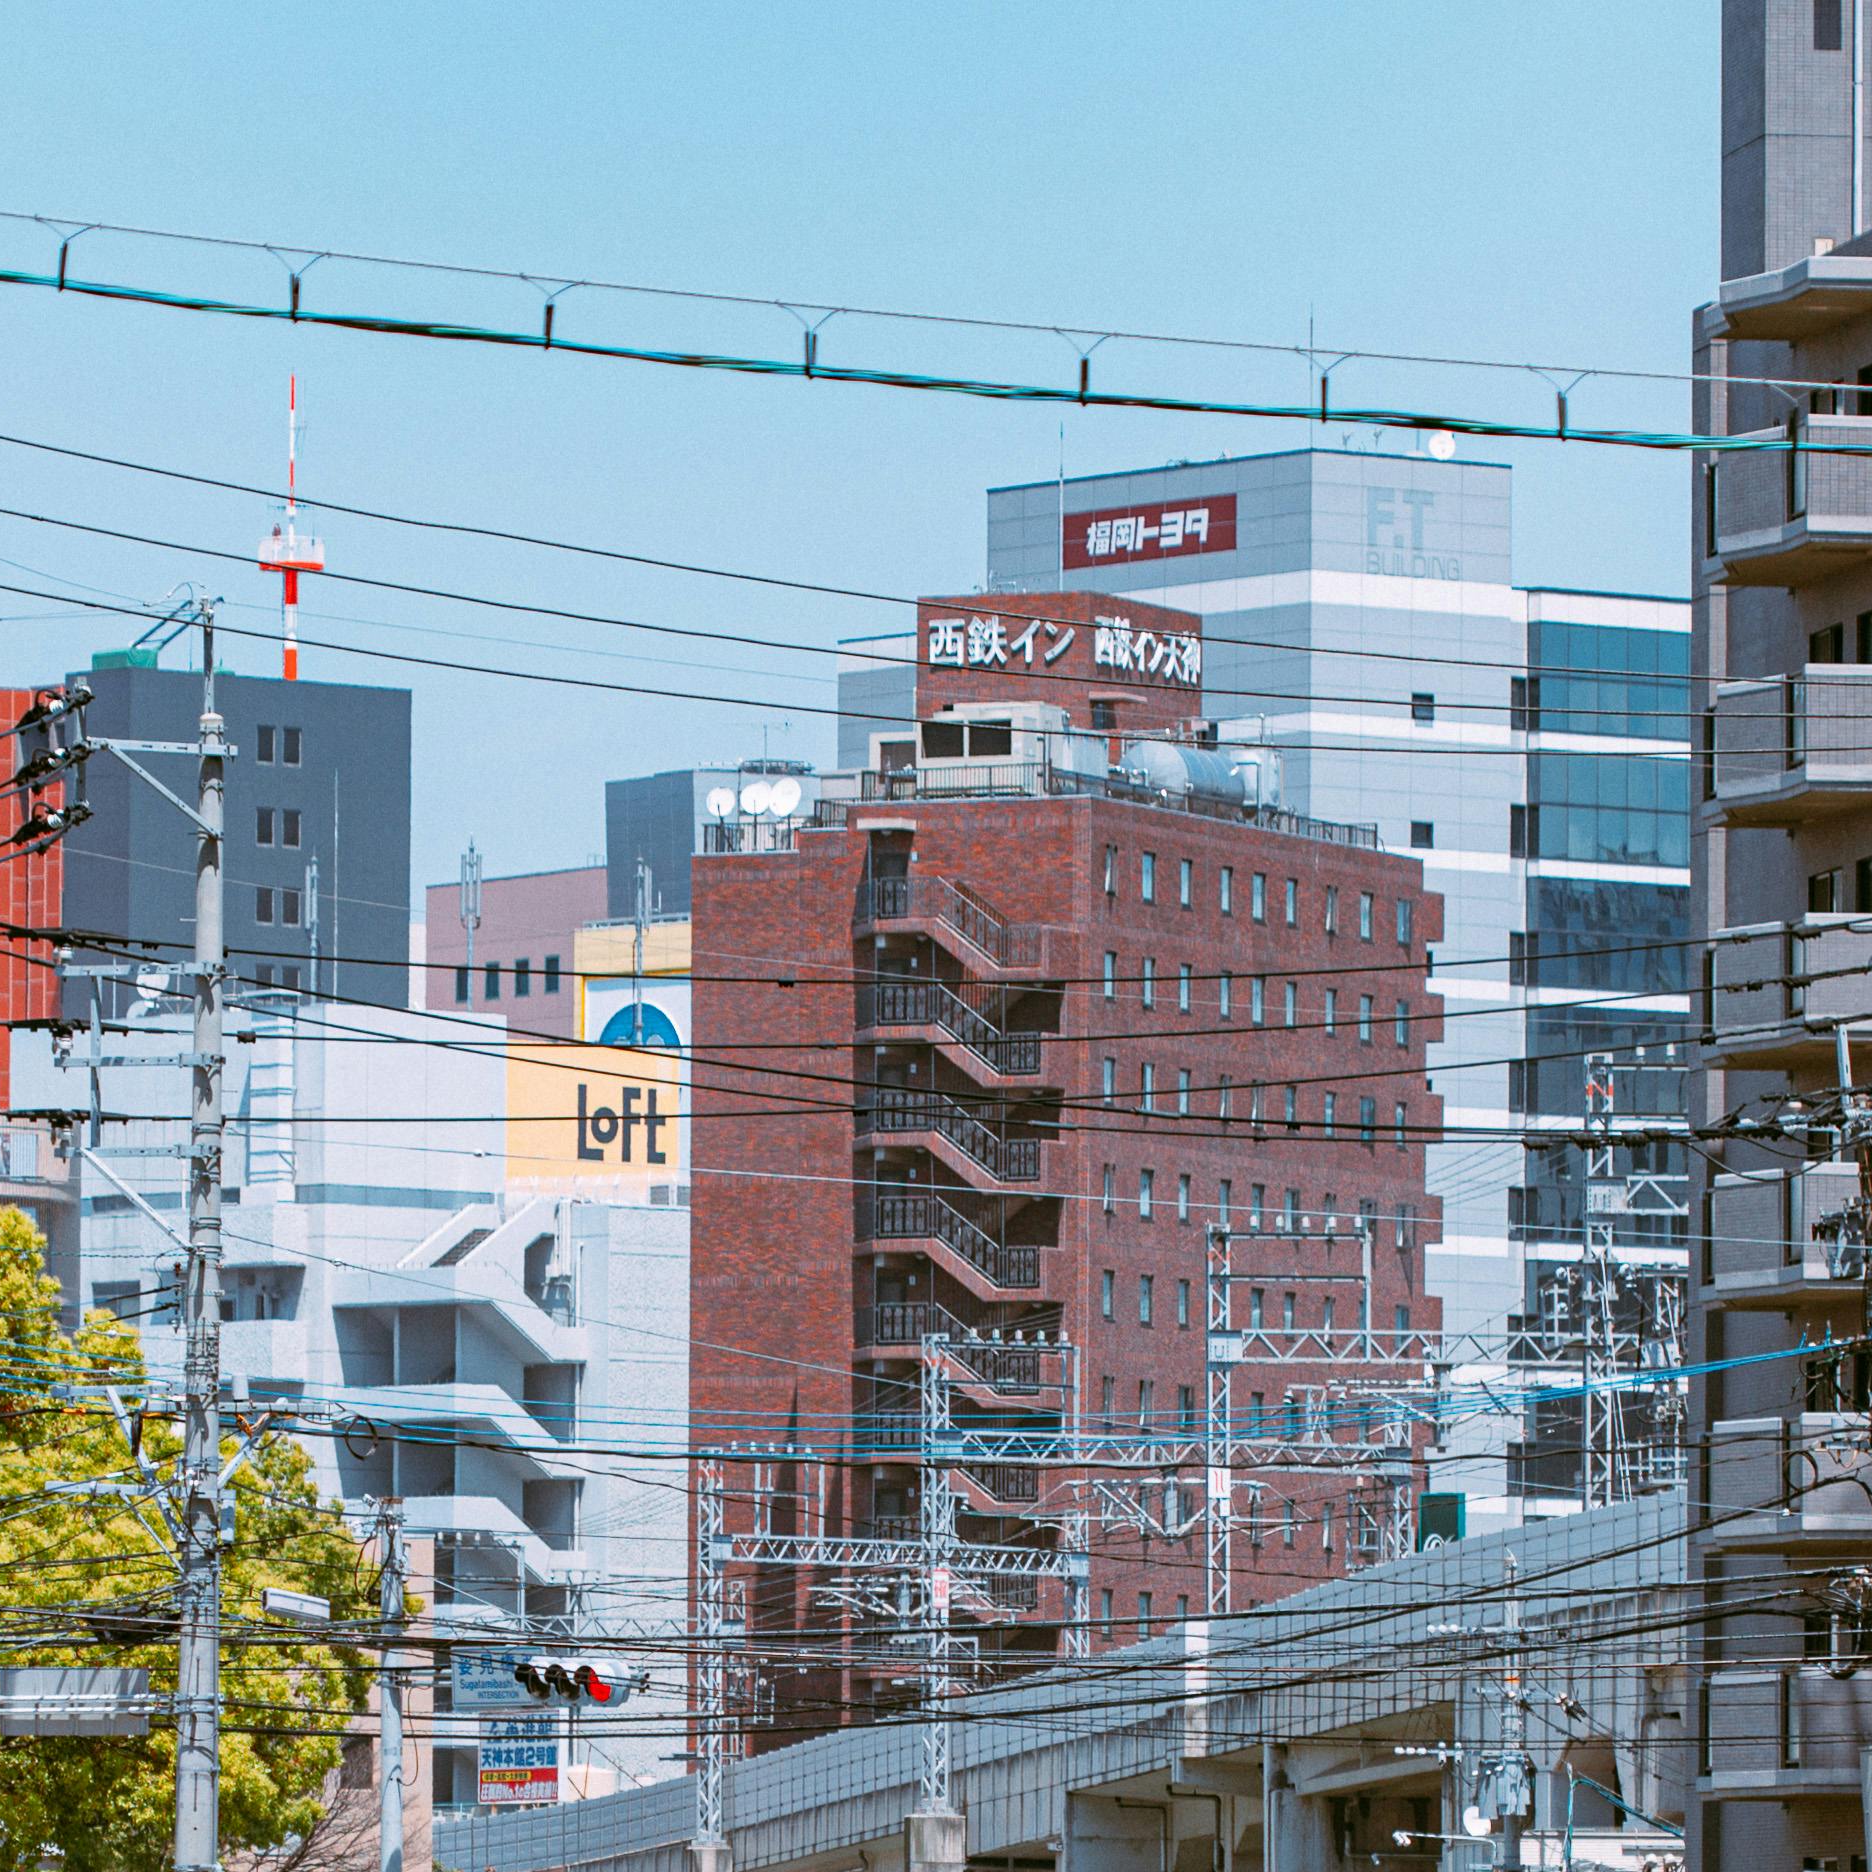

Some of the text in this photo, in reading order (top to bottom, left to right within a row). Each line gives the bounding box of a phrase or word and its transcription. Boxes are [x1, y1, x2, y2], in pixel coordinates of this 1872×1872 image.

[1086, 508, 1210, 558] 福岡トヨタ
[927, 614, 1076, 667] 西鉄イン
[1094, 614, 1201, 685] 西鉄イン天神
[457, 1653, 532, 1677] 姿見橋
[478, 1690, 520, 1700] INTERSECTION
[481, 1746, 557, 1768] 天神本館2号館
